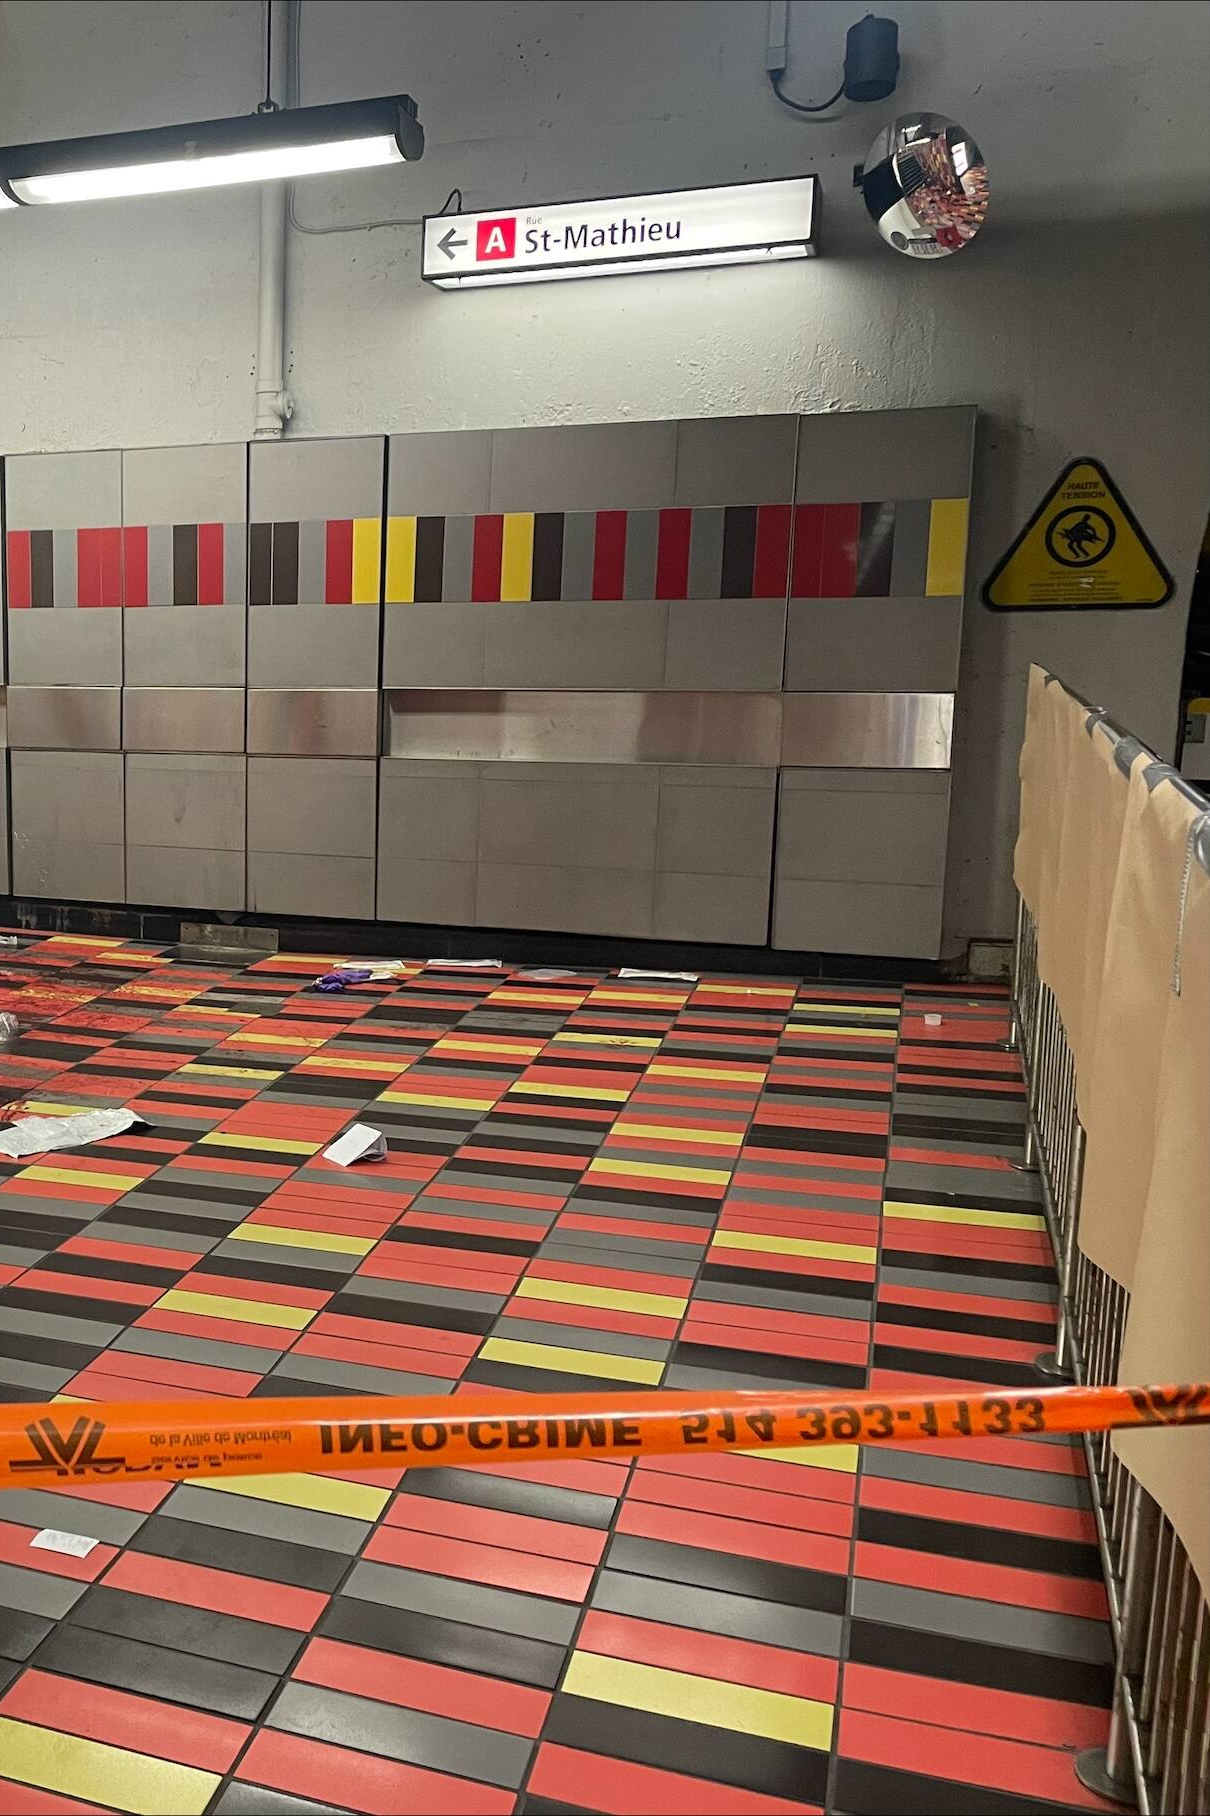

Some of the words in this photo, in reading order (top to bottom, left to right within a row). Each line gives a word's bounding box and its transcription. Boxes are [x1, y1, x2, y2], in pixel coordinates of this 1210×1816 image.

[526, 216, 542, 225] Rue
[525, 217, 681, 254] St-Mathieu
[485, 227, 507, 254] A
[1067, 481, 1100, 490] HAUTE
[1061, 491, 1106, 500] TENSION
